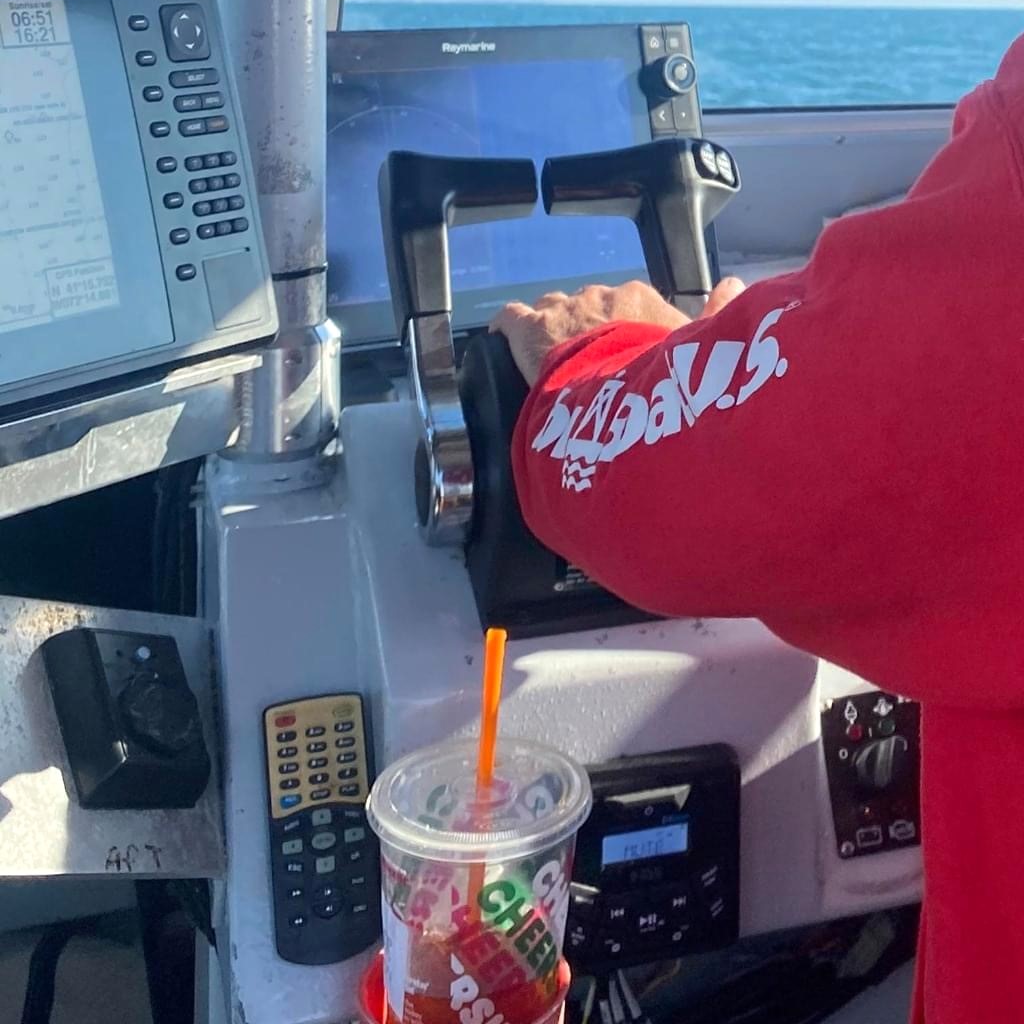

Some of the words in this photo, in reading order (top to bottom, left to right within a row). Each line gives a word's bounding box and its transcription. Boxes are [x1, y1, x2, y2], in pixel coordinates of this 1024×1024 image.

[11, 10, 53, 27] 06:51
[15, 26, 56, 43] 16:21
[441, 41, 496, 55] Raymarine
